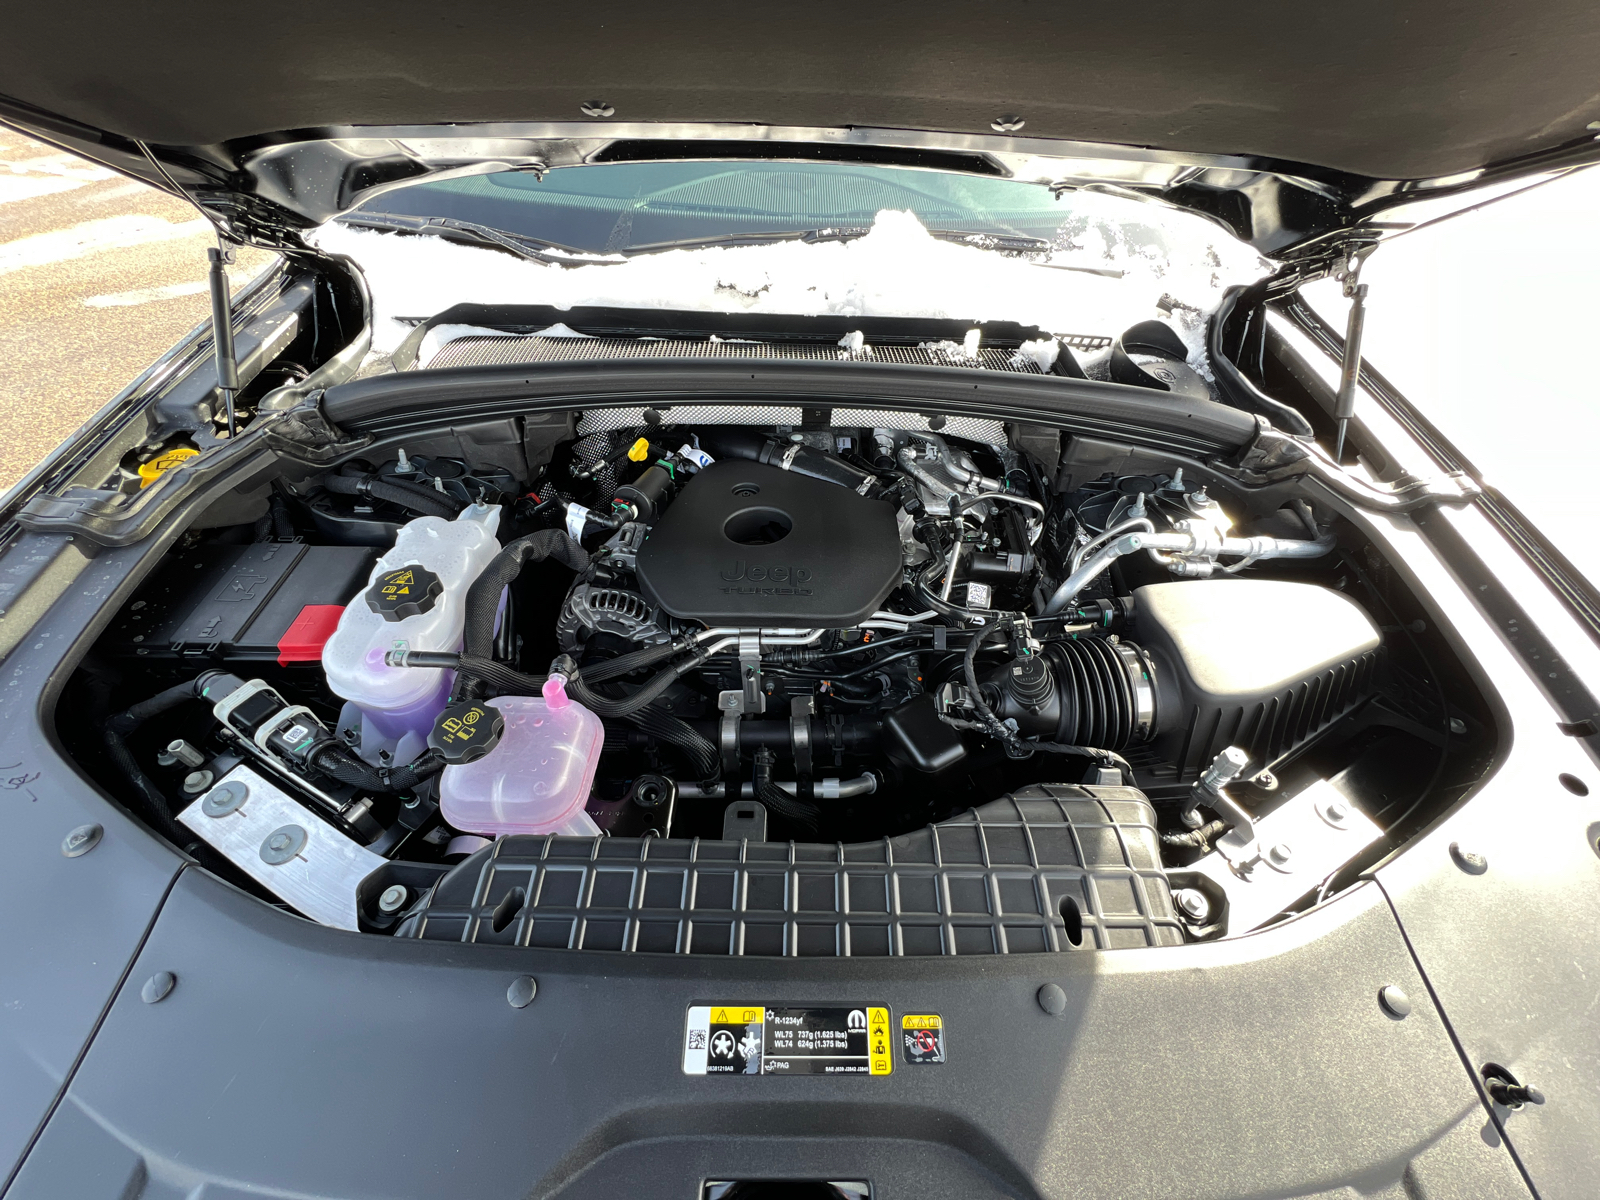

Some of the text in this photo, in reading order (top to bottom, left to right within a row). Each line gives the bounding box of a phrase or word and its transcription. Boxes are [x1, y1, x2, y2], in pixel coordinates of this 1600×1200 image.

[720, 560, 813, 586] Jeep
[718, 586, 813, 596] TURBO
[774, 1016, 803, 1026] R-1234yf
[774, 1030, 848, 1040] WL75 737g (1.625 lbs)
[774, 1040, 848, 1049] WL74 624g (1.375 lbs)
[777, 1061, 790, 1069] PAG
